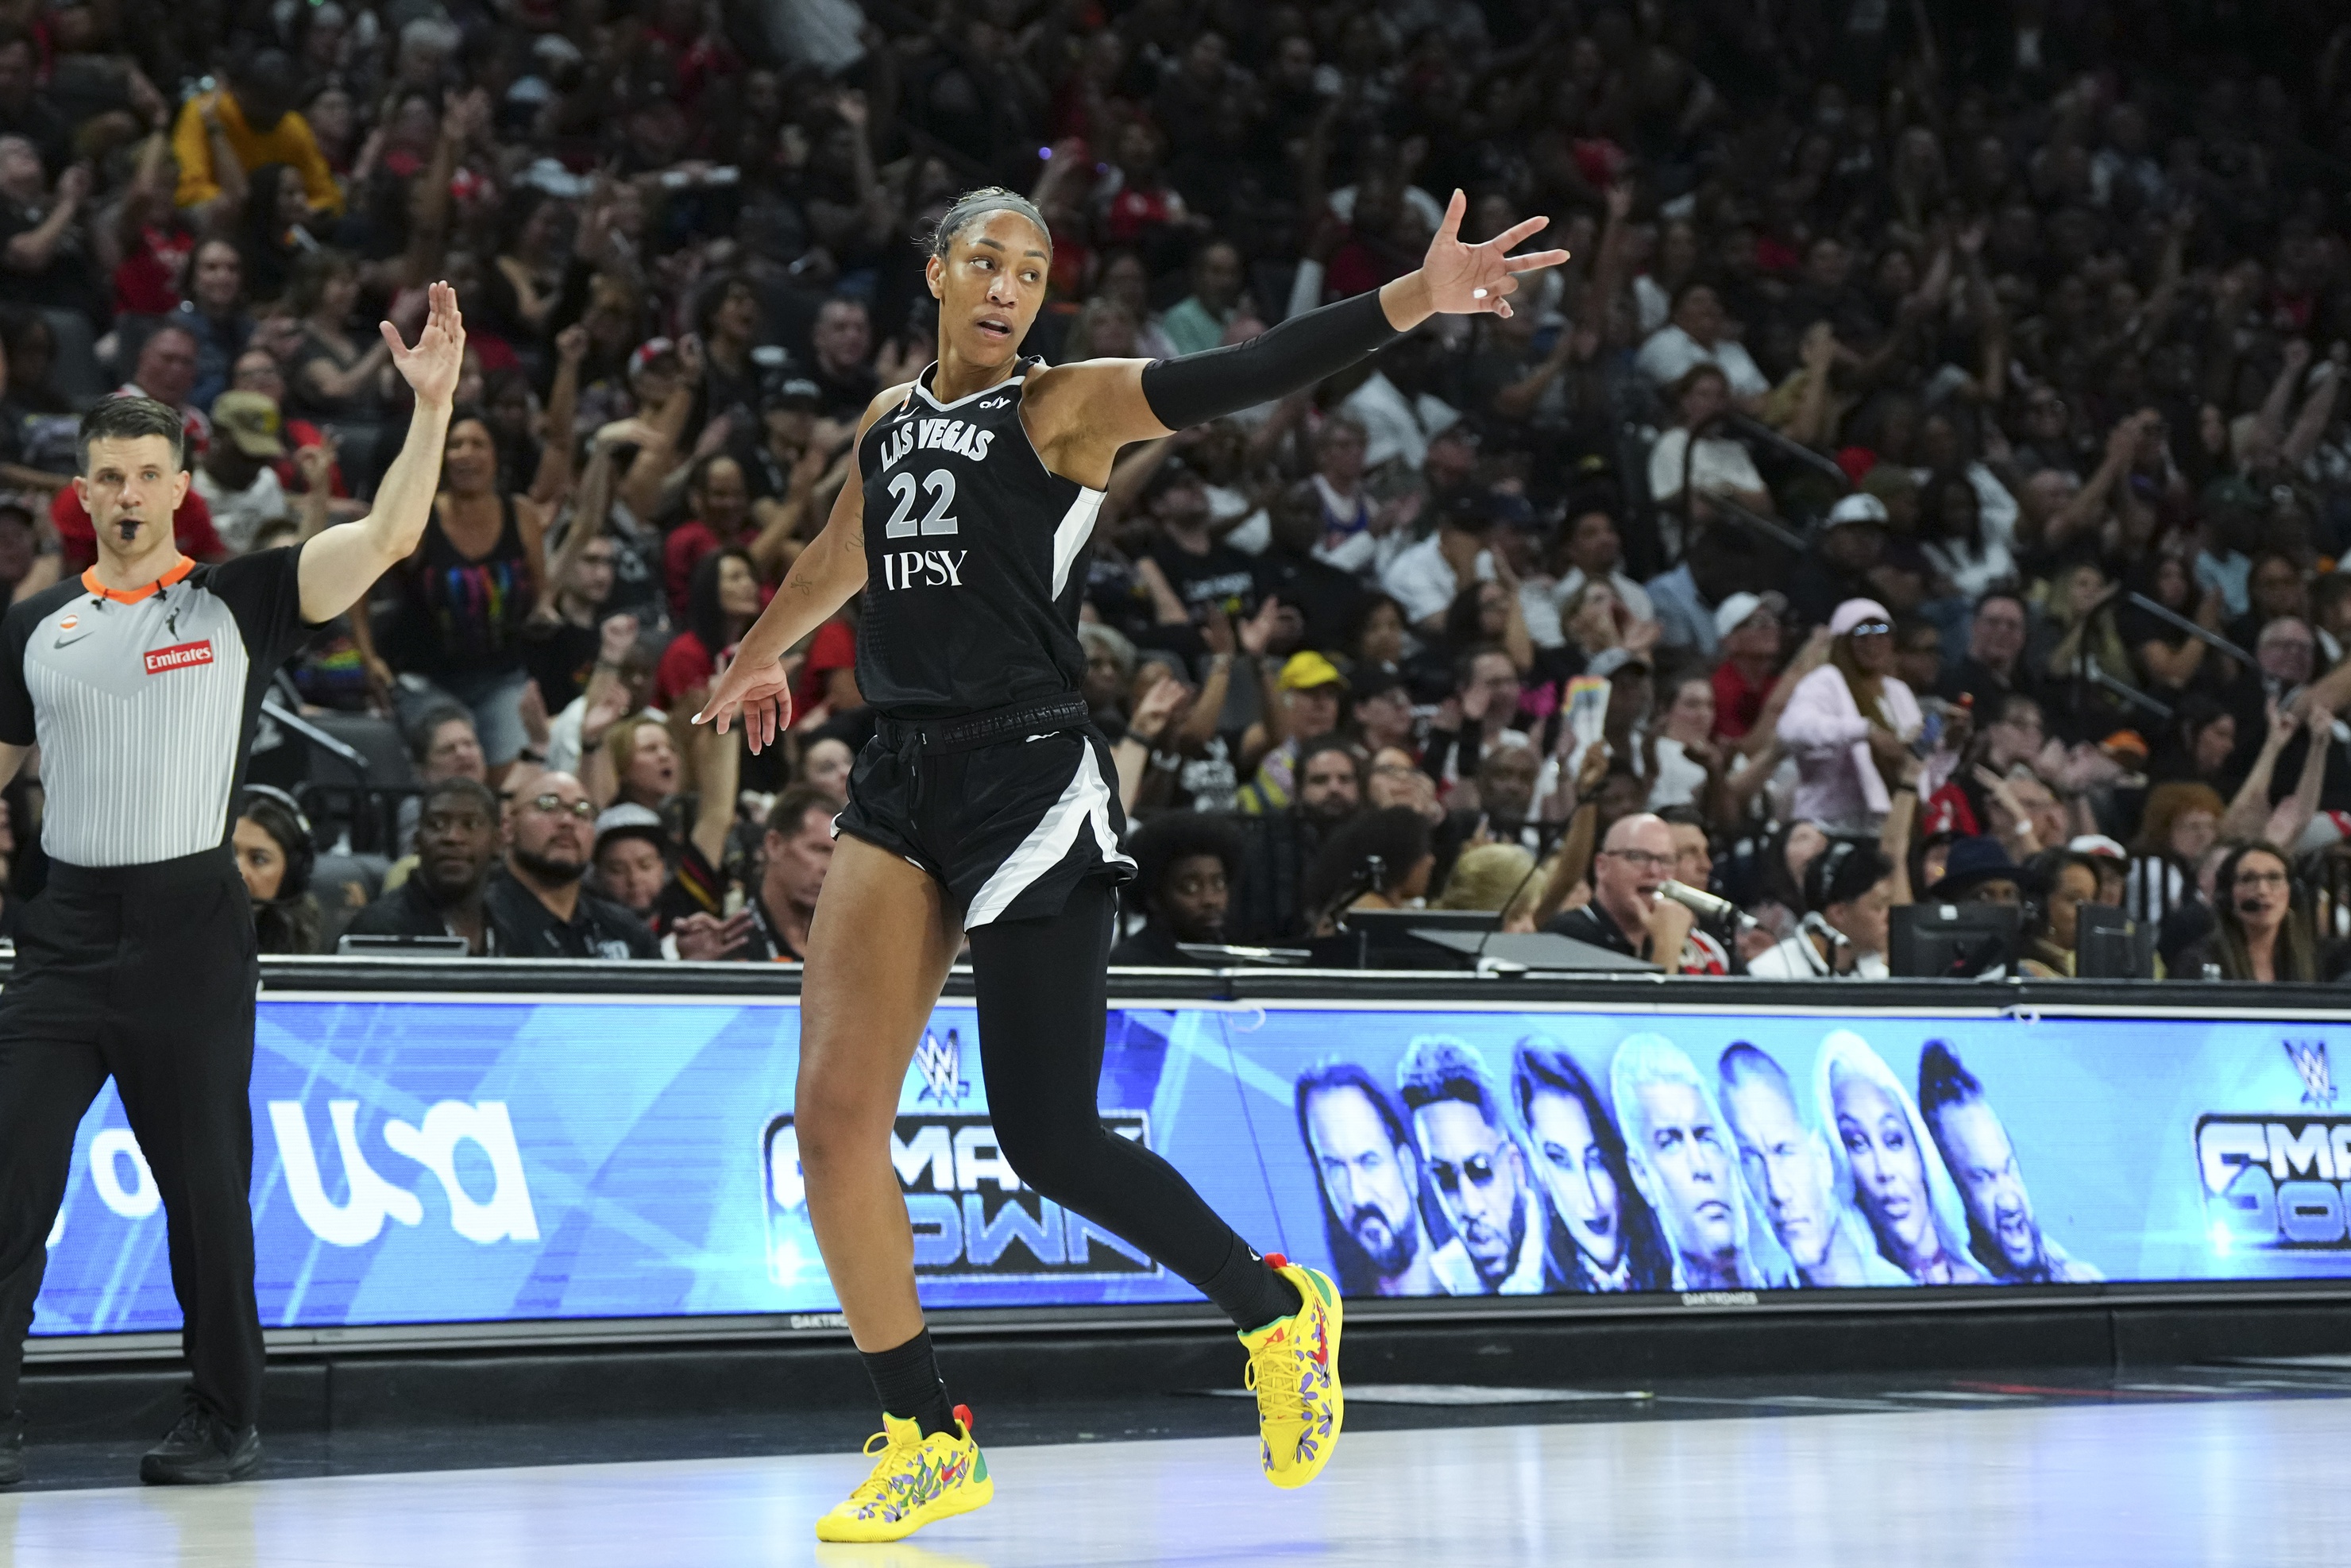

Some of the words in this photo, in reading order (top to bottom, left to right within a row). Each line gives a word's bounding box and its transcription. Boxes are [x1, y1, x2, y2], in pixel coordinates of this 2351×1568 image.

[880, 419, 914, 473] LAS
[917, 418, 995, 462] VEGAS
[886, 469, 959, 539] 22
[883, 550, 967, 591] IPSY
[145, 647, 211, 670] Emirates
